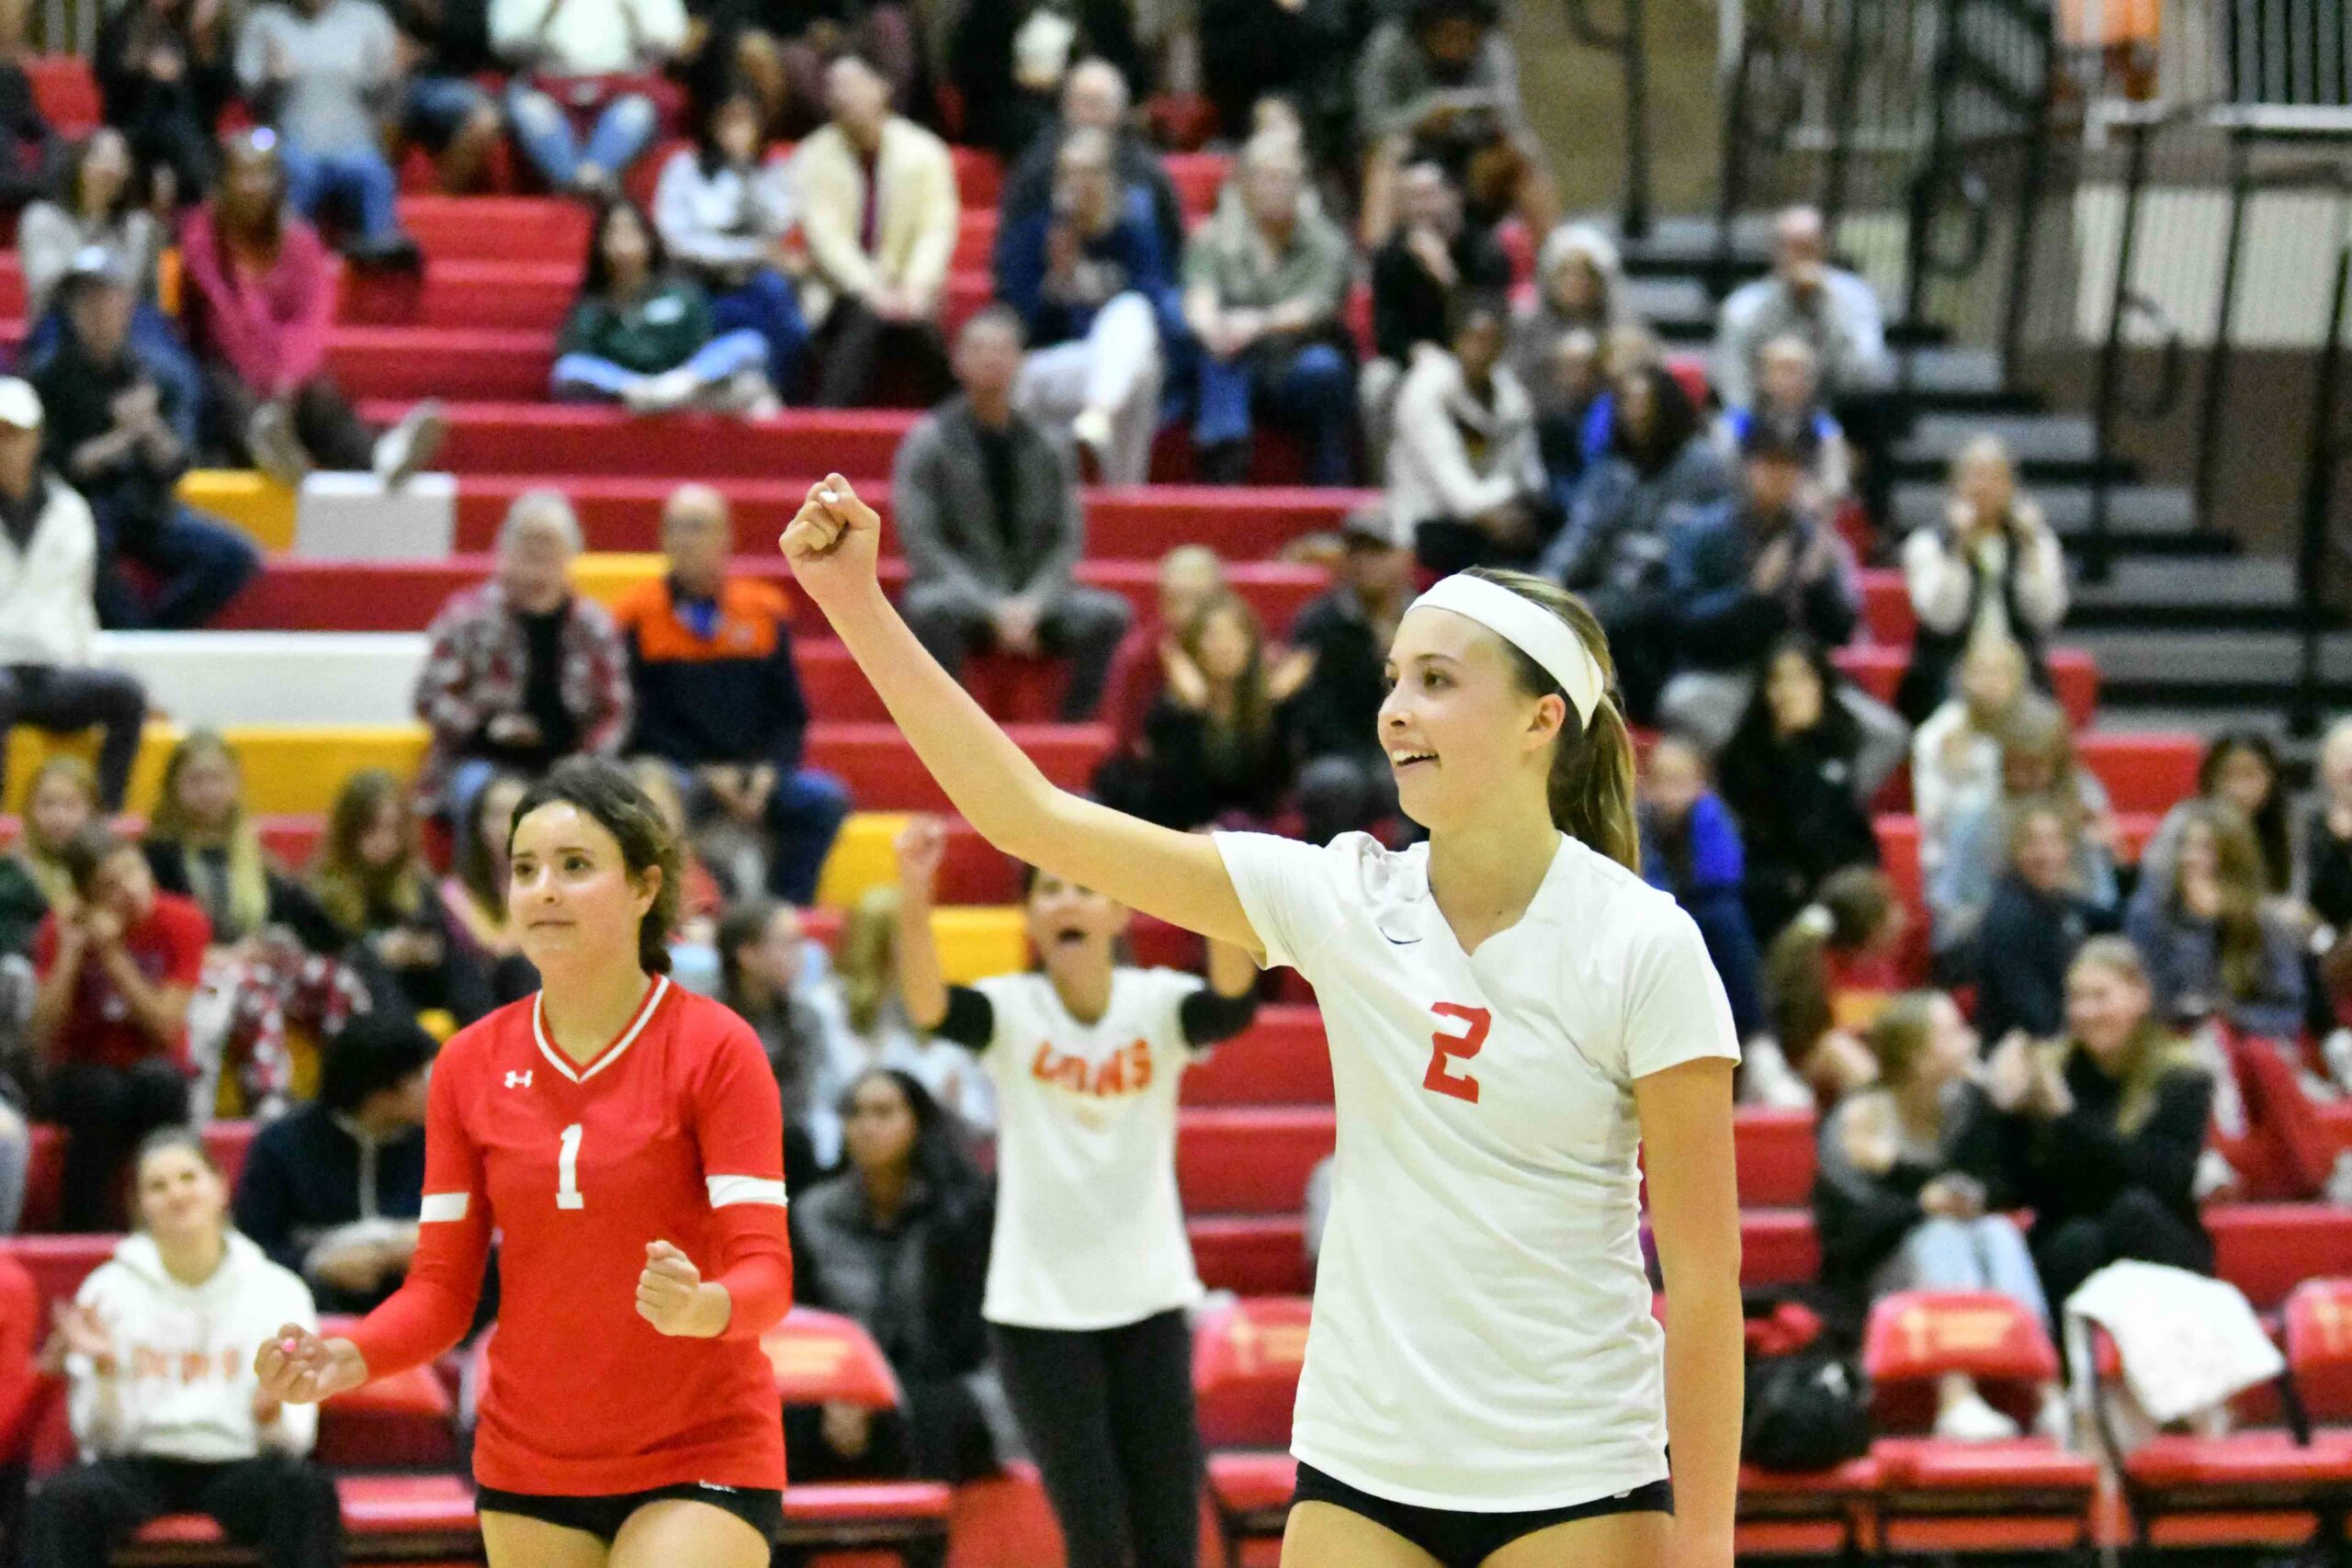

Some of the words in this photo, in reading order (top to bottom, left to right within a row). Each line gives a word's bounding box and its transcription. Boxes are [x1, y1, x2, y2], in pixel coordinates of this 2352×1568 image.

[1031, 1039, 1153, 1097] LONS
[1423, 1002, 1491, 1104] 2
[556, 1122, 583, 1210] 1
